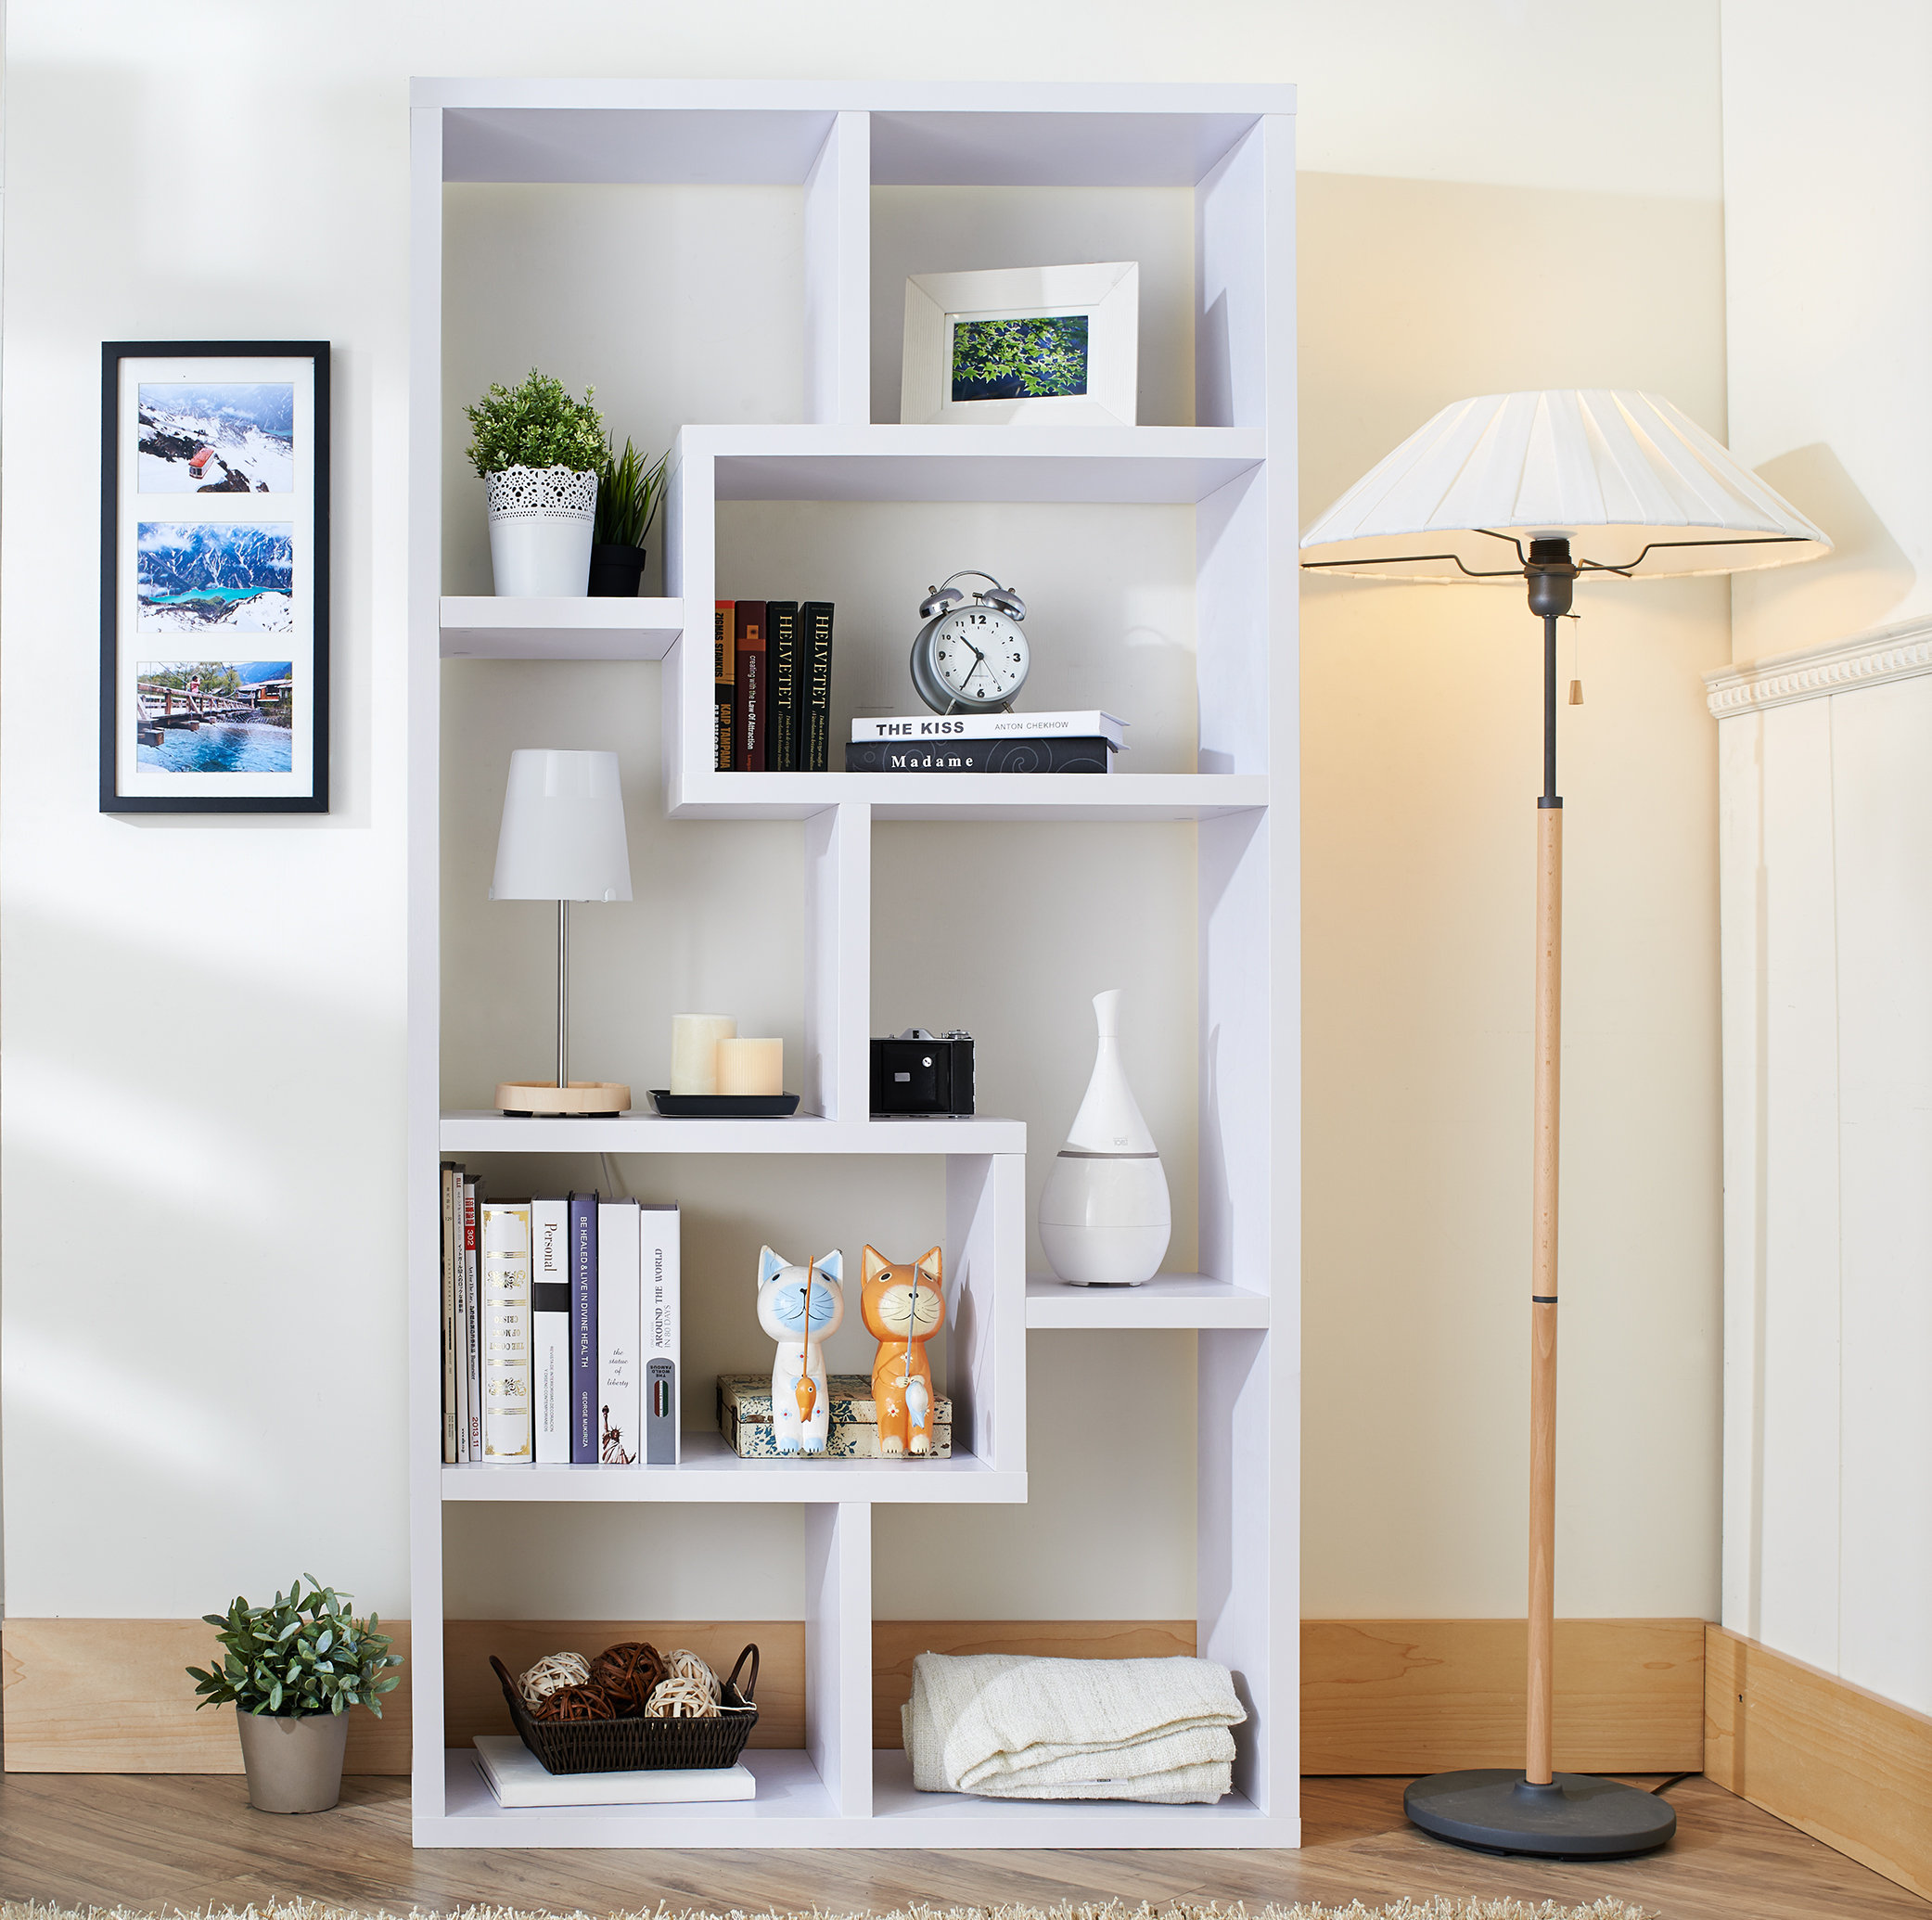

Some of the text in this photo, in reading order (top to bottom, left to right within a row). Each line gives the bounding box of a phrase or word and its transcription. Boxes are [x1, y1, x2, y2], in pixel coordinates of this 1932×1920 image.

[969, 615, 987, 624] 12
[715, 612, 723, 678] ZIGMAS STANKUS
[939, 651, 946, 660] 9
[1013, 653, 1021, 662] 3
[748, 655, 758, 678] creating
[779, 616, 792, 709] HELVETET
[812, 616, 829, 709] HELVETET
[977, 688, 985, 698] 6
[748, 700, 757, 712] Law
[876, 721, 965, 736] THE KISS
[994, 721, 1069, 731] ANTON CHEKHOW
[720, 704, 731, 769] KAIP TAMPAMA
[747, 721, 757, 749] Attraction
[890, 755, 974, 768] Madame
[580, 1216, 588, 1228] BE
[544, 1222, 558, 1272] Personal
[580, 1229, 588, 1263] HEALED
[580, 1272, 588, 1291] LIVE
[581, 1293, 588, 1301] IN
[655, 1248, 663, 1349] AROUND THE WORLD
[664, 1327, 672, 1338] 80
[511, 1342, 525, 1350] THE
[664, 1339, 672, 1348] IN
[581, 1333, 589, 1368] HEALTH
[614, 1366, 622, 1376] of
[607, 1378, 629, 1389] liberty
